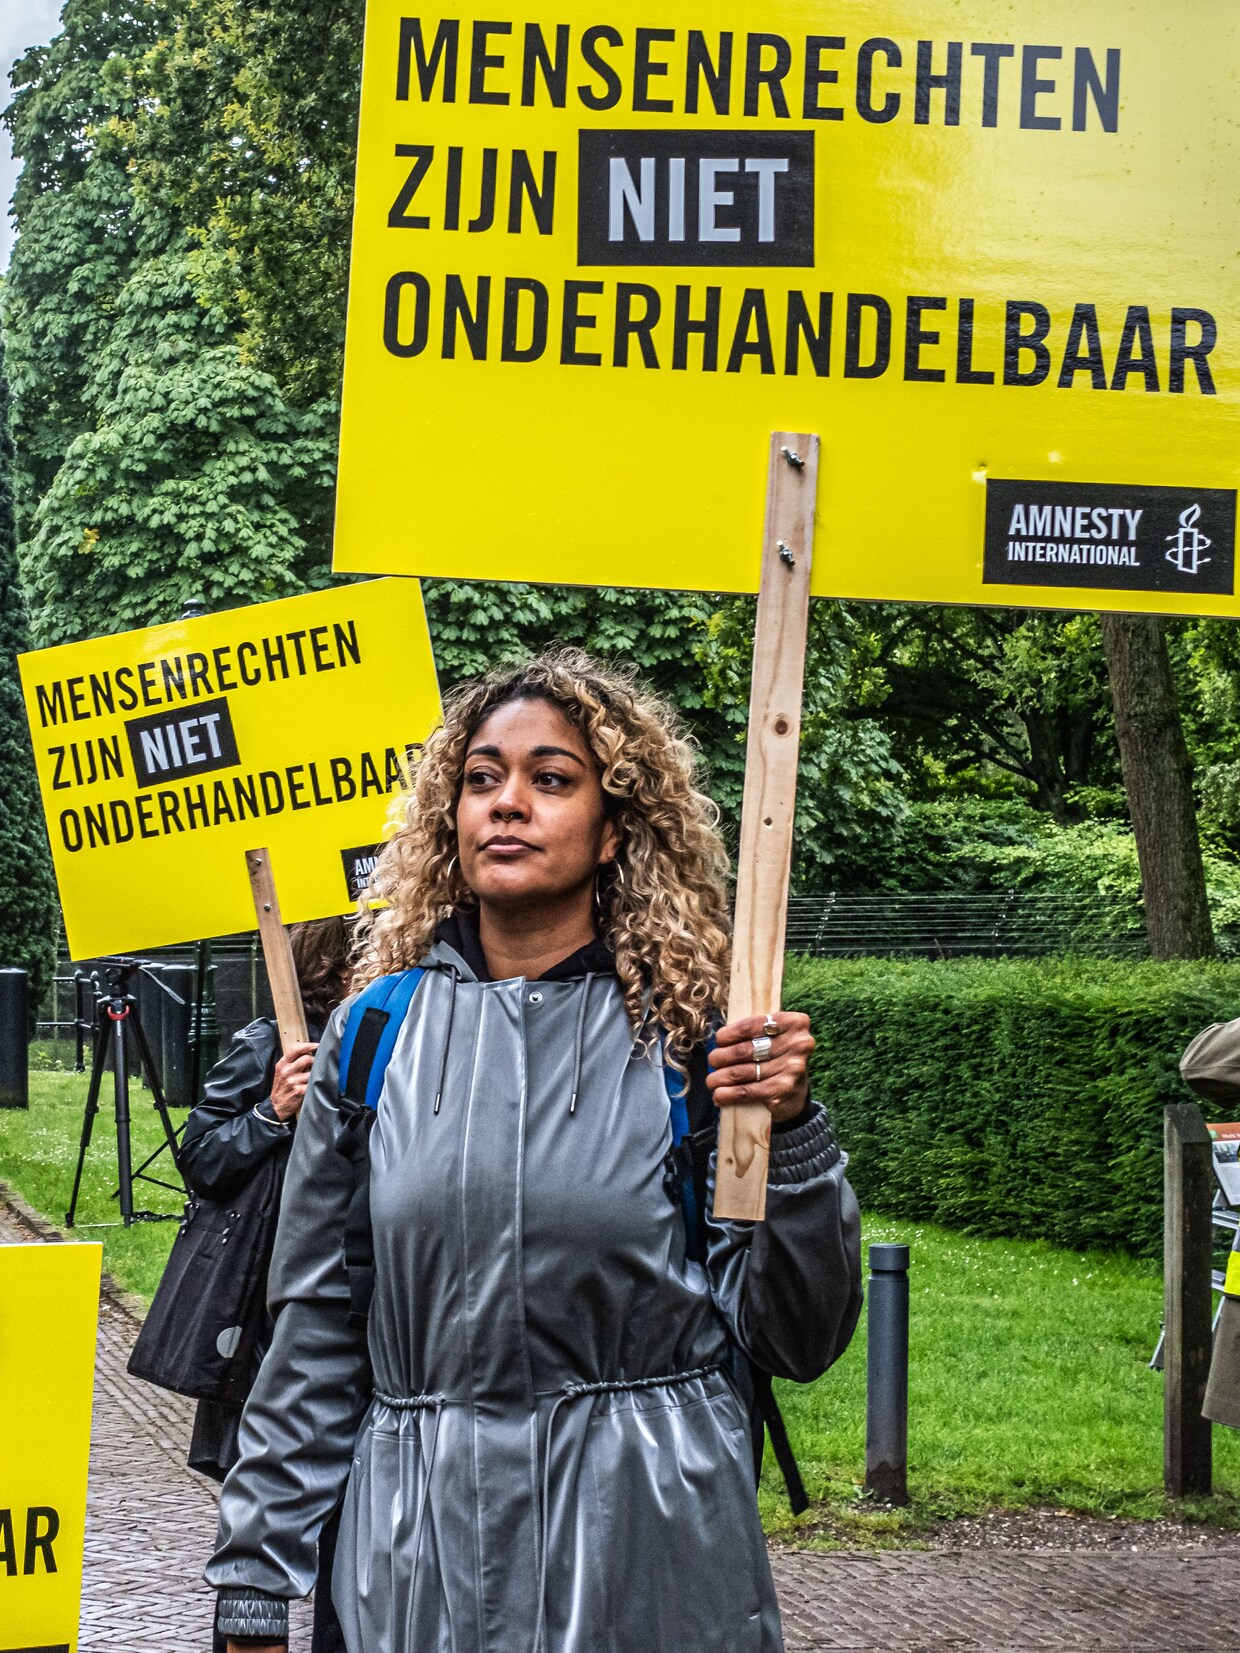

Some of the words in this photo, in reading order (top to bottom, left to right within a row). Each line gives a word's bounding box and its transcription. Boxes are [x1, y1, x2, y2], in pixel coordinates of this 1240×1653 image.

[395, 16, 1121, 133] MENSENRECHTEN
[387, 143, 557, 236] ZIJN
[608, 157, 790, 243] NIET
[382, 271, 1218, 395] ONDERHANDELBAAR
[1005, 541, 1141, 567] INTERNATIONAL
[1007, 503, 1144, 542] AMNESTY
[35, 620, 361, 728] MENSENRECHTEN
[47, 735, 125, 791] ZIJN
[139, 712, 222, 774] NIET
